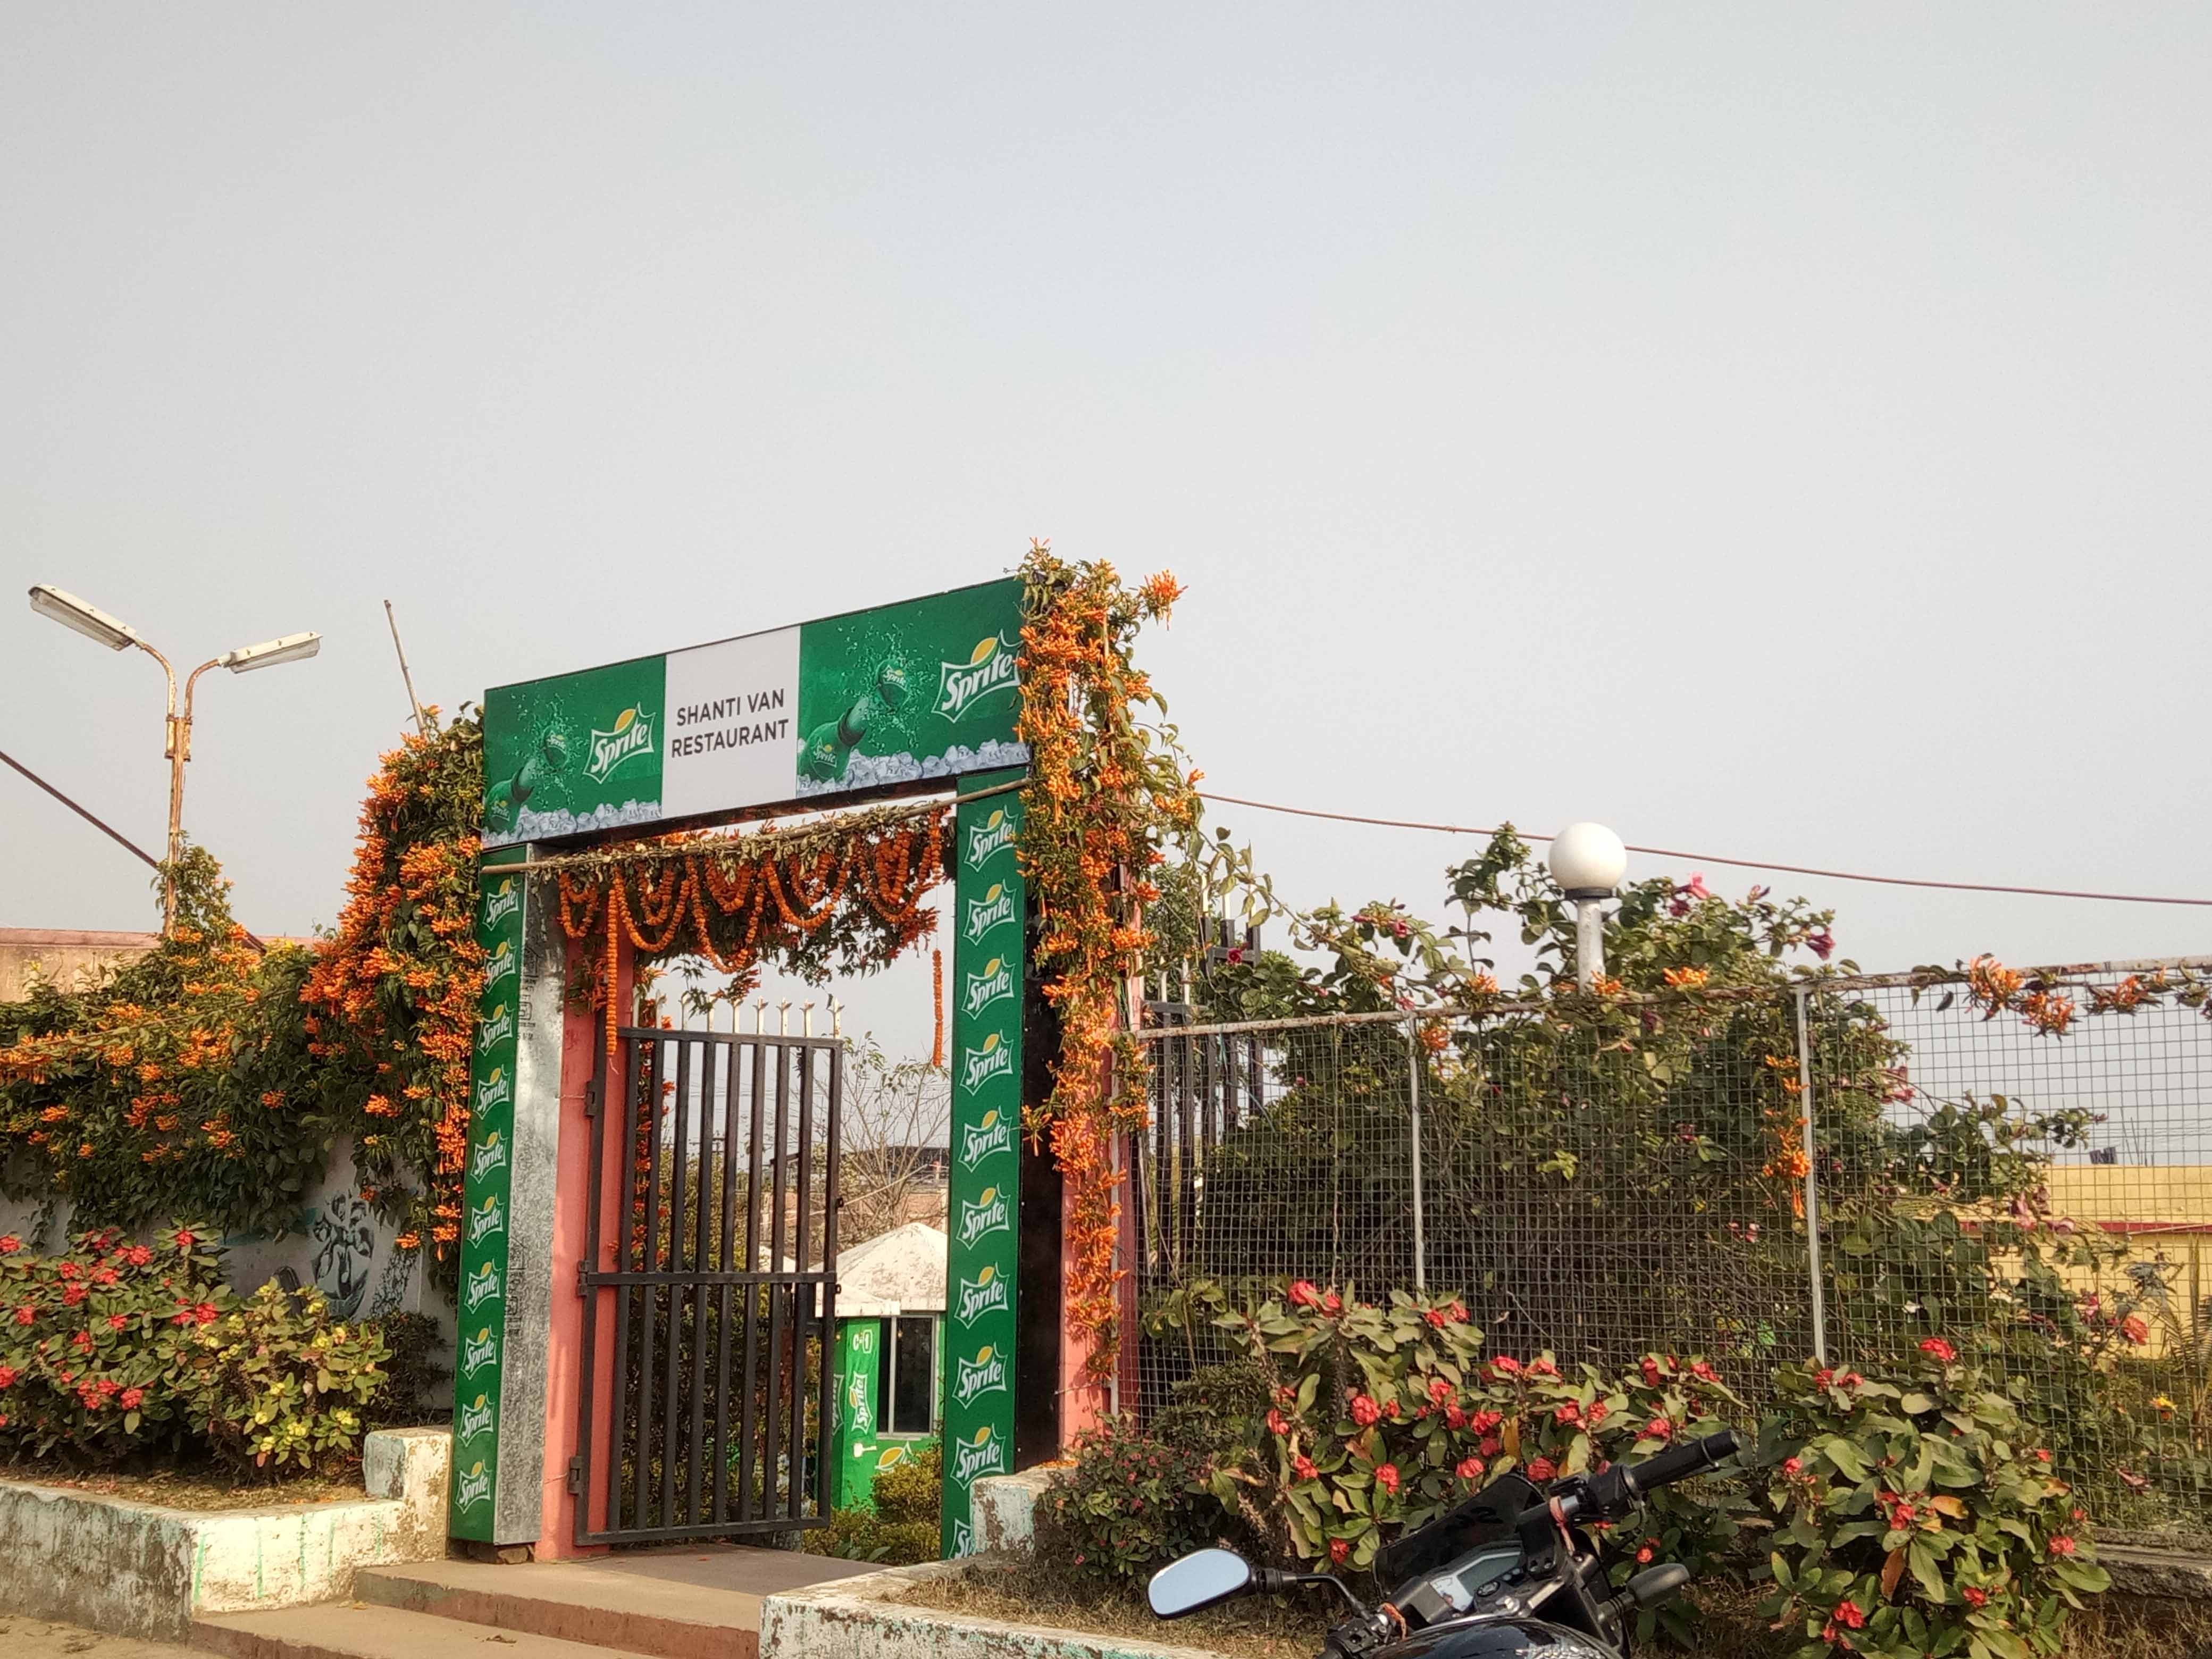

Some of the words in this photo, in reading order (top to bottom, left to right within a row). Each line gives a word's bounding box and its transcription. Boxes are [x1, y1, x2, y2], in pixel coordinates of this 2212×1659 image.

[941, 647, 1012, 711] Sprite
[676, 696, 741, 726] SHANTI
[747, 689, 784, 713] VAN
[591, 717, 648, 774] Sprite
[671, 719, 789, 758] RESTAURANT
[970, 817, 1011, 862] Sprite
[486, 888, 516, 925] Sprite
[970, 891, 1010, 936] Sprite
[483, 952, 512, 986] Sprite
[969, 965, 1009, 1011] Sprite
[480, 1014, 509, 1050] Sprite
[968, 1042, 1008, 1086] Sprite
[477, 1076, 507, 1113] Sprite
[474, 1140, 503, 1177] Sprite
[965, 1119, 1007, 1164] Sprite
[471, 1205, 500, 1243] Sprite
[962, 1196, 1004, 1240] Sprite
[468, 1270, 497, 1307] Sprite
[960, 1275, 1003, 1319] Sprite
[465, 1338, 494, 1372] Sprite
[958, 1356, 1001, 1400] Sprite
[462, 1405, 491, 1440] Sprite
[852, 1378, 868, 1427] Sprite
[957, 1437, 1000, 1479] Sprite
[459, 1473, 488, 1508] Sprite
